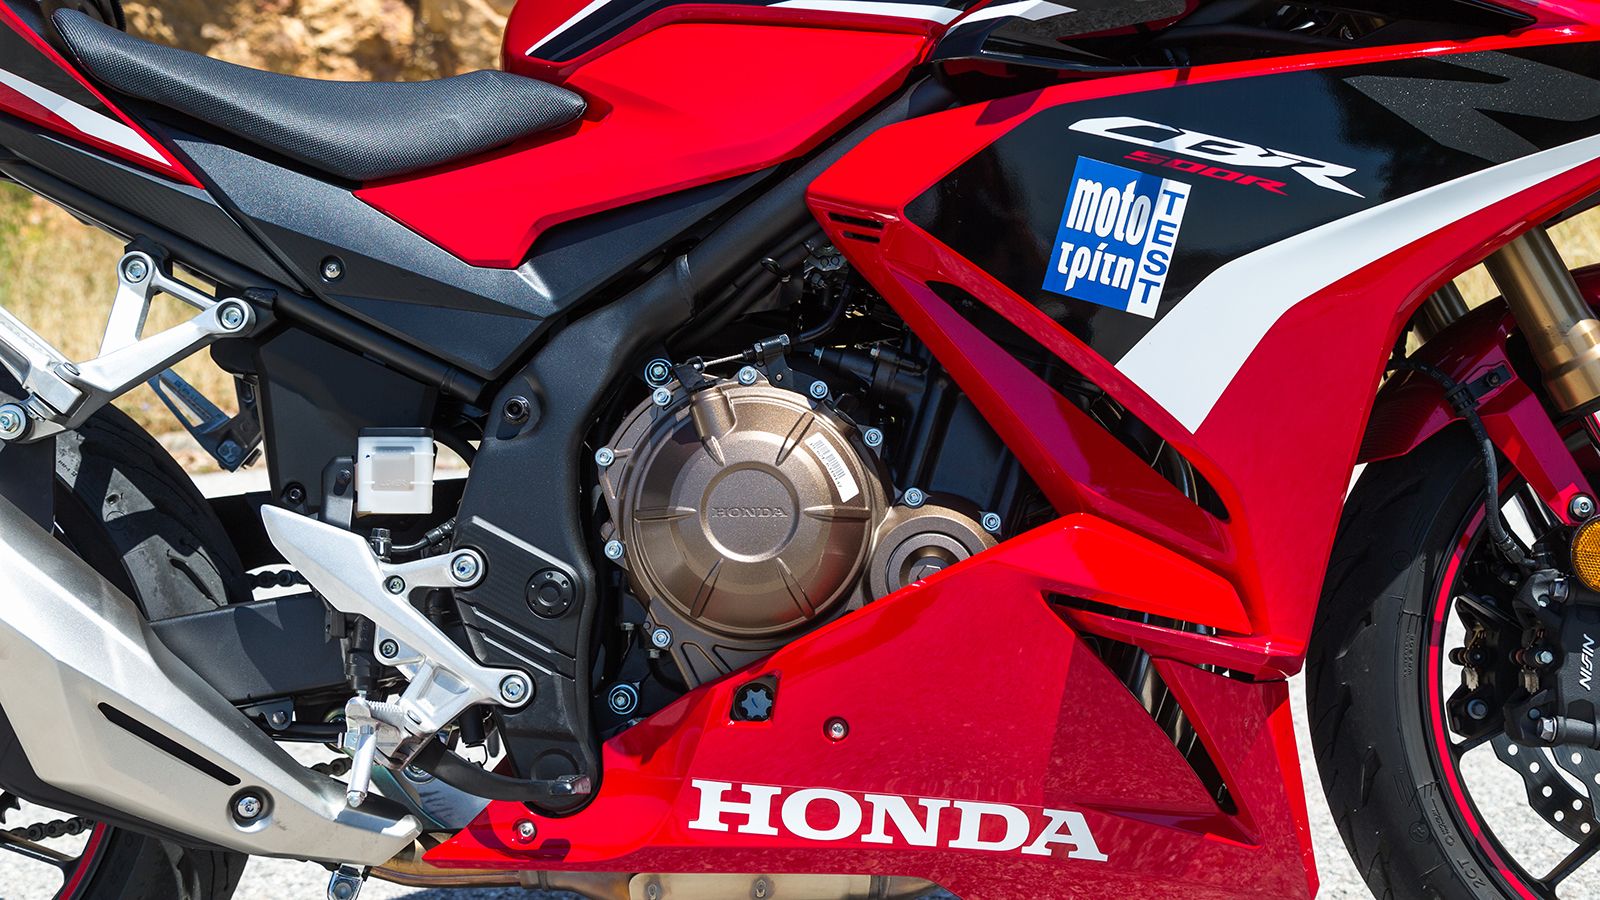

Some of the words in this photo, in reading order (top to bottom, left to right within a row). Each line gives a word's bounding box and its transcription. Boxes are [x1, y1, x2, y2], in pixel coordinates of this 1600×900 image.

[1068, 116, 1366, 198] CBR
[1123, 150, 1289, 197] 500R
[1066, 178, 1152, 246] moto
[1138, 189, 1185, 305] TEST
[711, 506, 788, 518] HONDA
[688, 778, 1109, 862] HONDA
